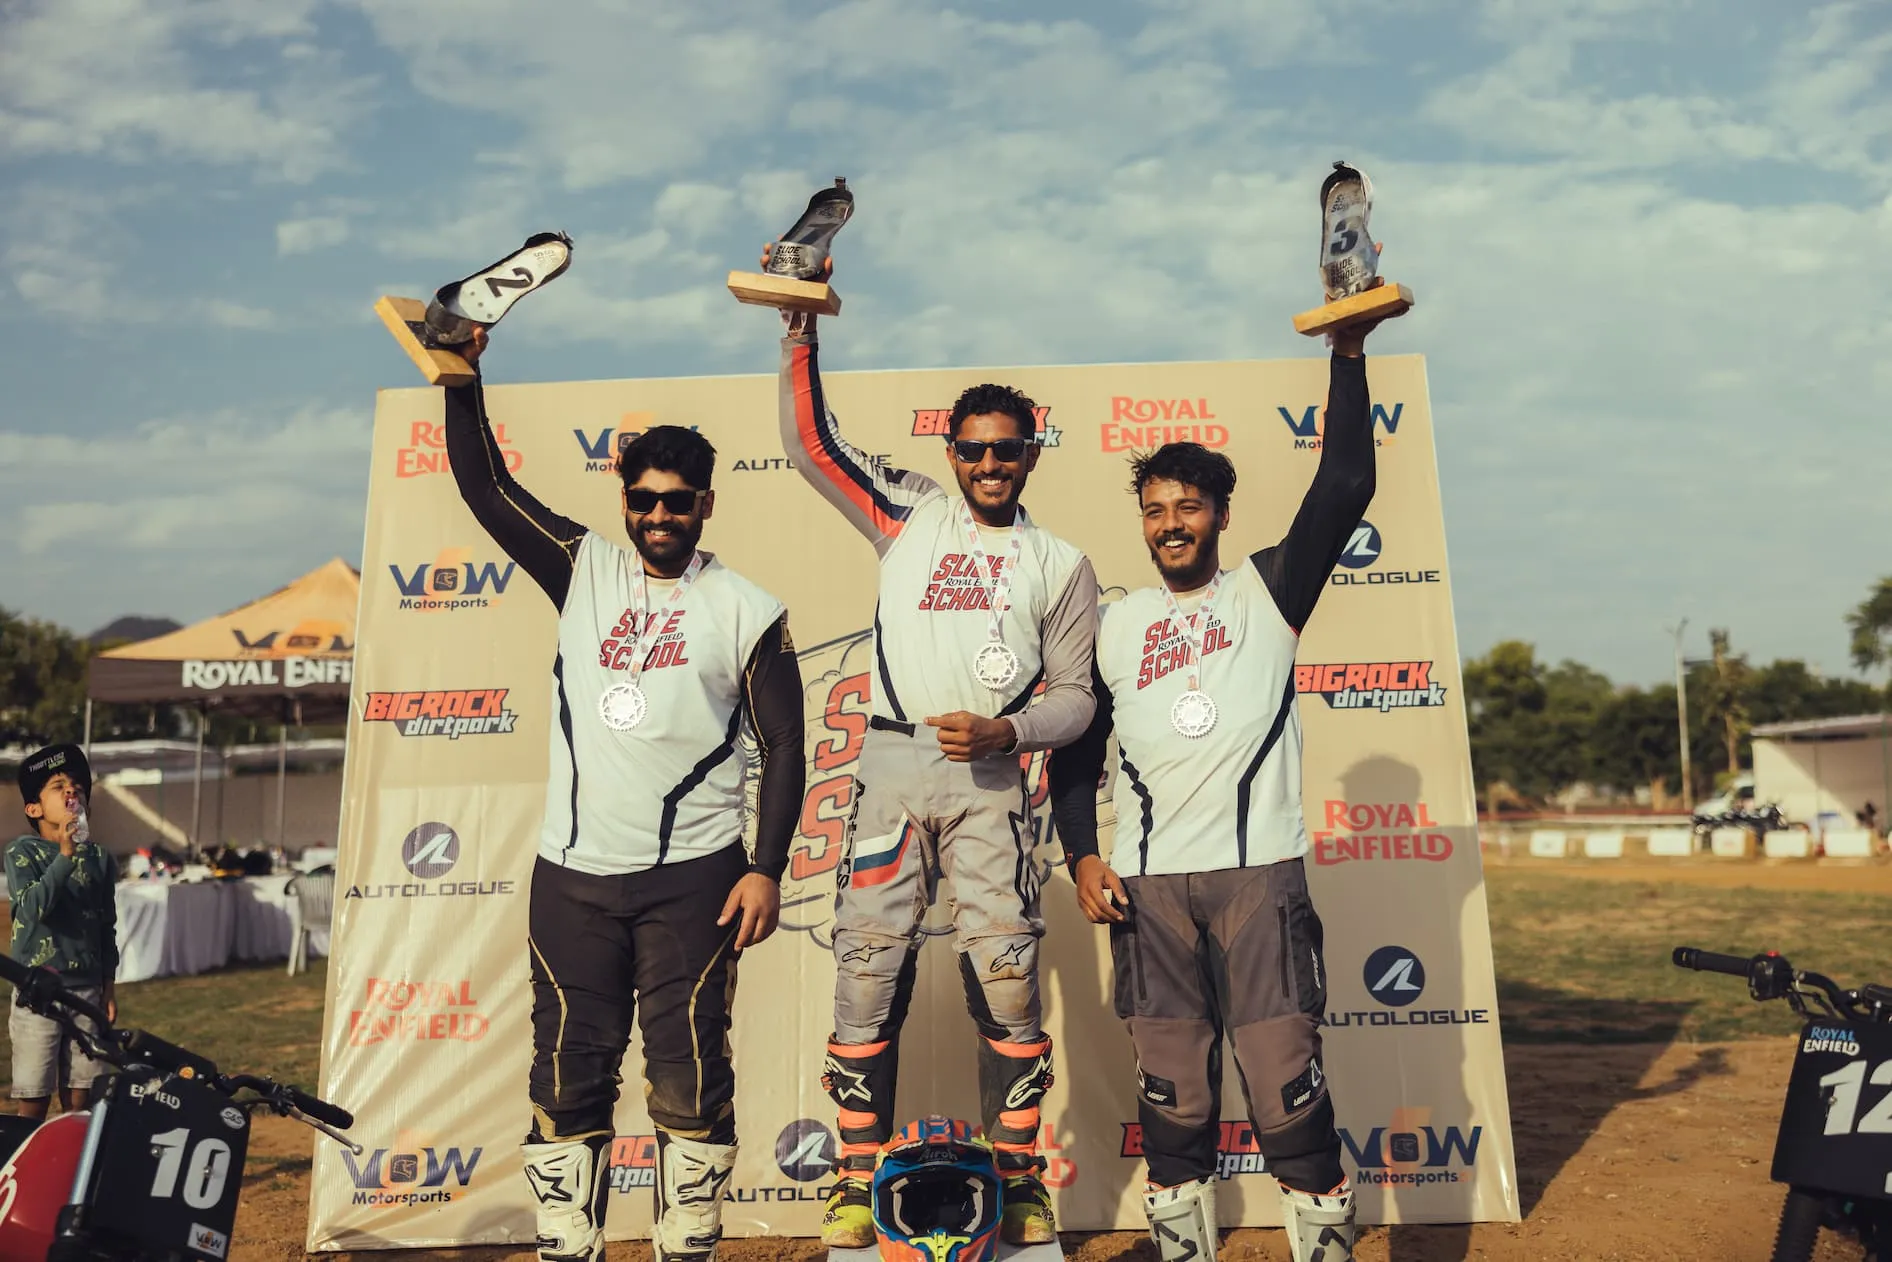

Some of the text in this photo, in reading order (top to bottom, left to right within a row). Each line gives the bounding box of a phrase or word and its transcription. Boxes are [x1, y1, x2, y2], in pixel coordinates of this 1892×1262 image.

[485, 267, 534, 298] 2
[1111, 396, 1216, 424] ROYAL
[1101, 423, 1230, 453] ENFIELD
[1331, 570, 1441, 586] OLOGUE
[399, 597, 489, 611] Motorsports
[918, 583, 1011, 611] SCHOO
[182, 656, 352, 690] ROYAL ENFI
[1295, 661, 1434, 694] BIGROCK
[363, 688, 510, 722] BIGROCK
[1331, 682, 1447, 712] dirtpark
[404, 709, 519, 740] dirtpark
[1324, 800, 1437, 832] ROYAL
[1312, 831, 1454, 867] ENFIELD
[344, 880, 515, 900] AUTOLOGUE
[367, 977, 478, 1011] ROYAL
[350, 1010, 490, 1047] ENFIELD
[1320, 1009, 1489, 1028] AUTOLOGUE
[1810, 1026, 1856, 1041] ROYAL
[1803, 1039, 1861, 1057] ENFIELD
[150, 1127, 232, 1209] 10
[1357, 1170, 1459, 1187] Motorsports
[351, 1190, 452, 1207] Motorsports
